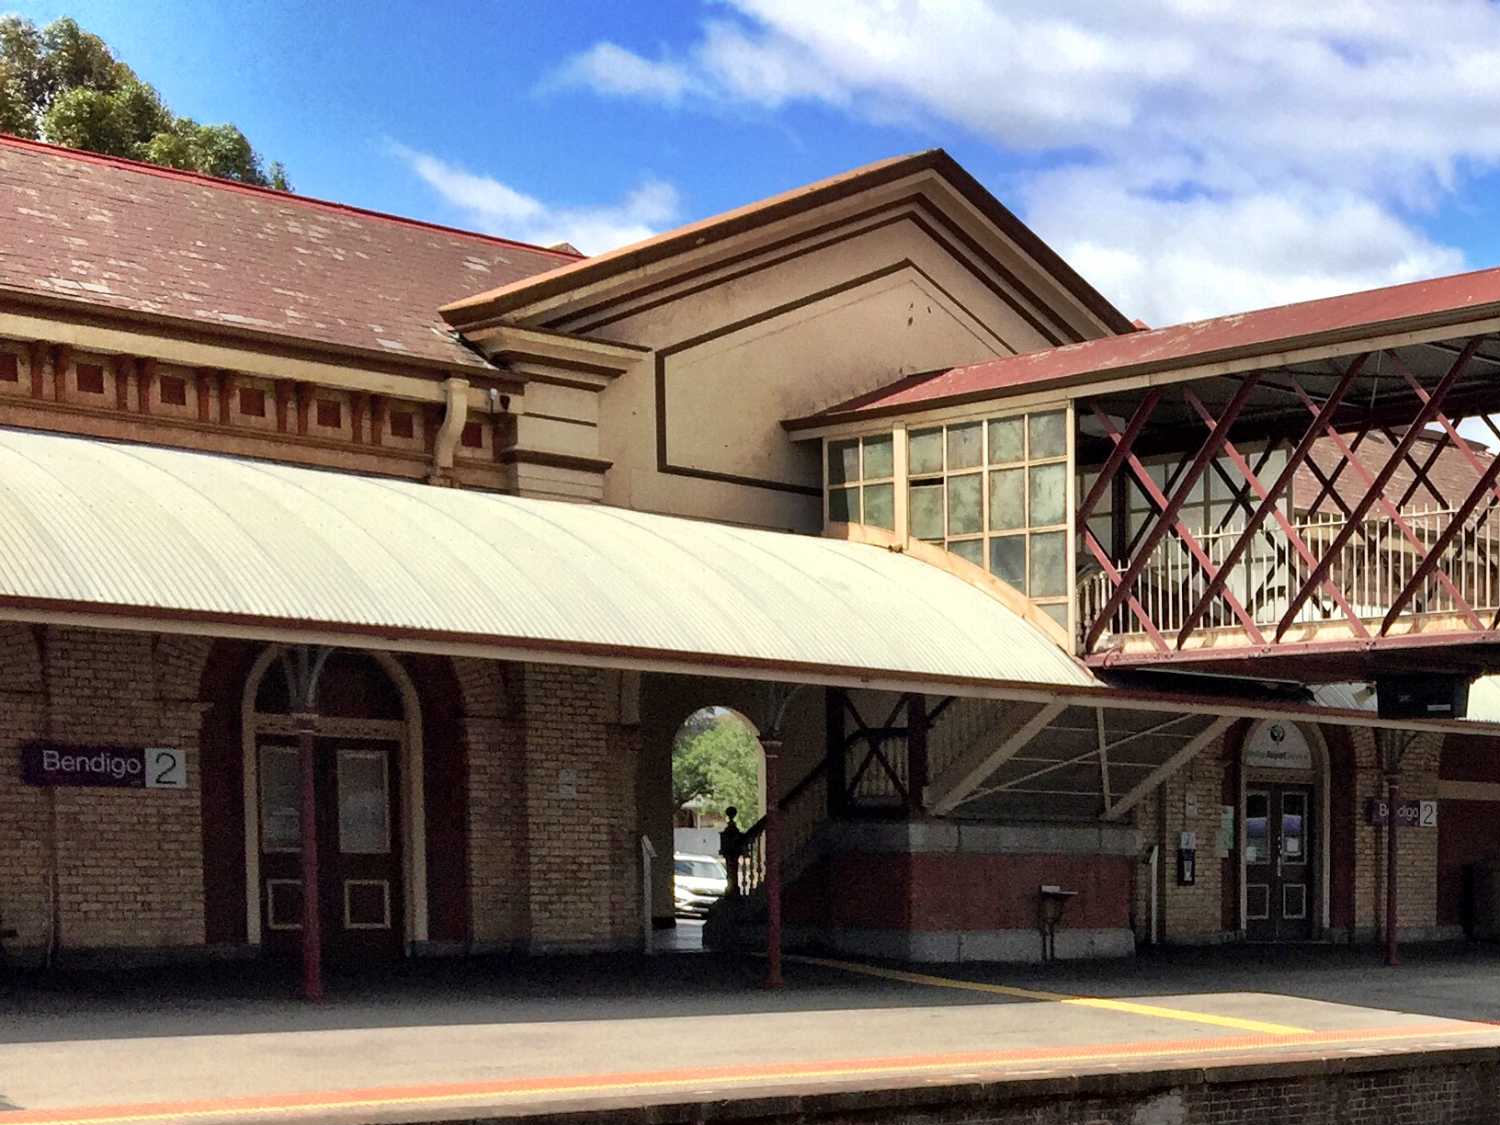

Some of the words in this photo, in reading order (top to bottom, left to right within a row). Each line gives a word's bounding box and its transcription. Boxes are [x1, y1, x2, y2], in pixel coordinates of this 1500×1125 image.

[43, 750, 141, 778] Bendigo
[155, 752, 177, 784] 2
[1379, 803, 1418, 821] Bdigo
[1423, 804, 1433, 825] 2
